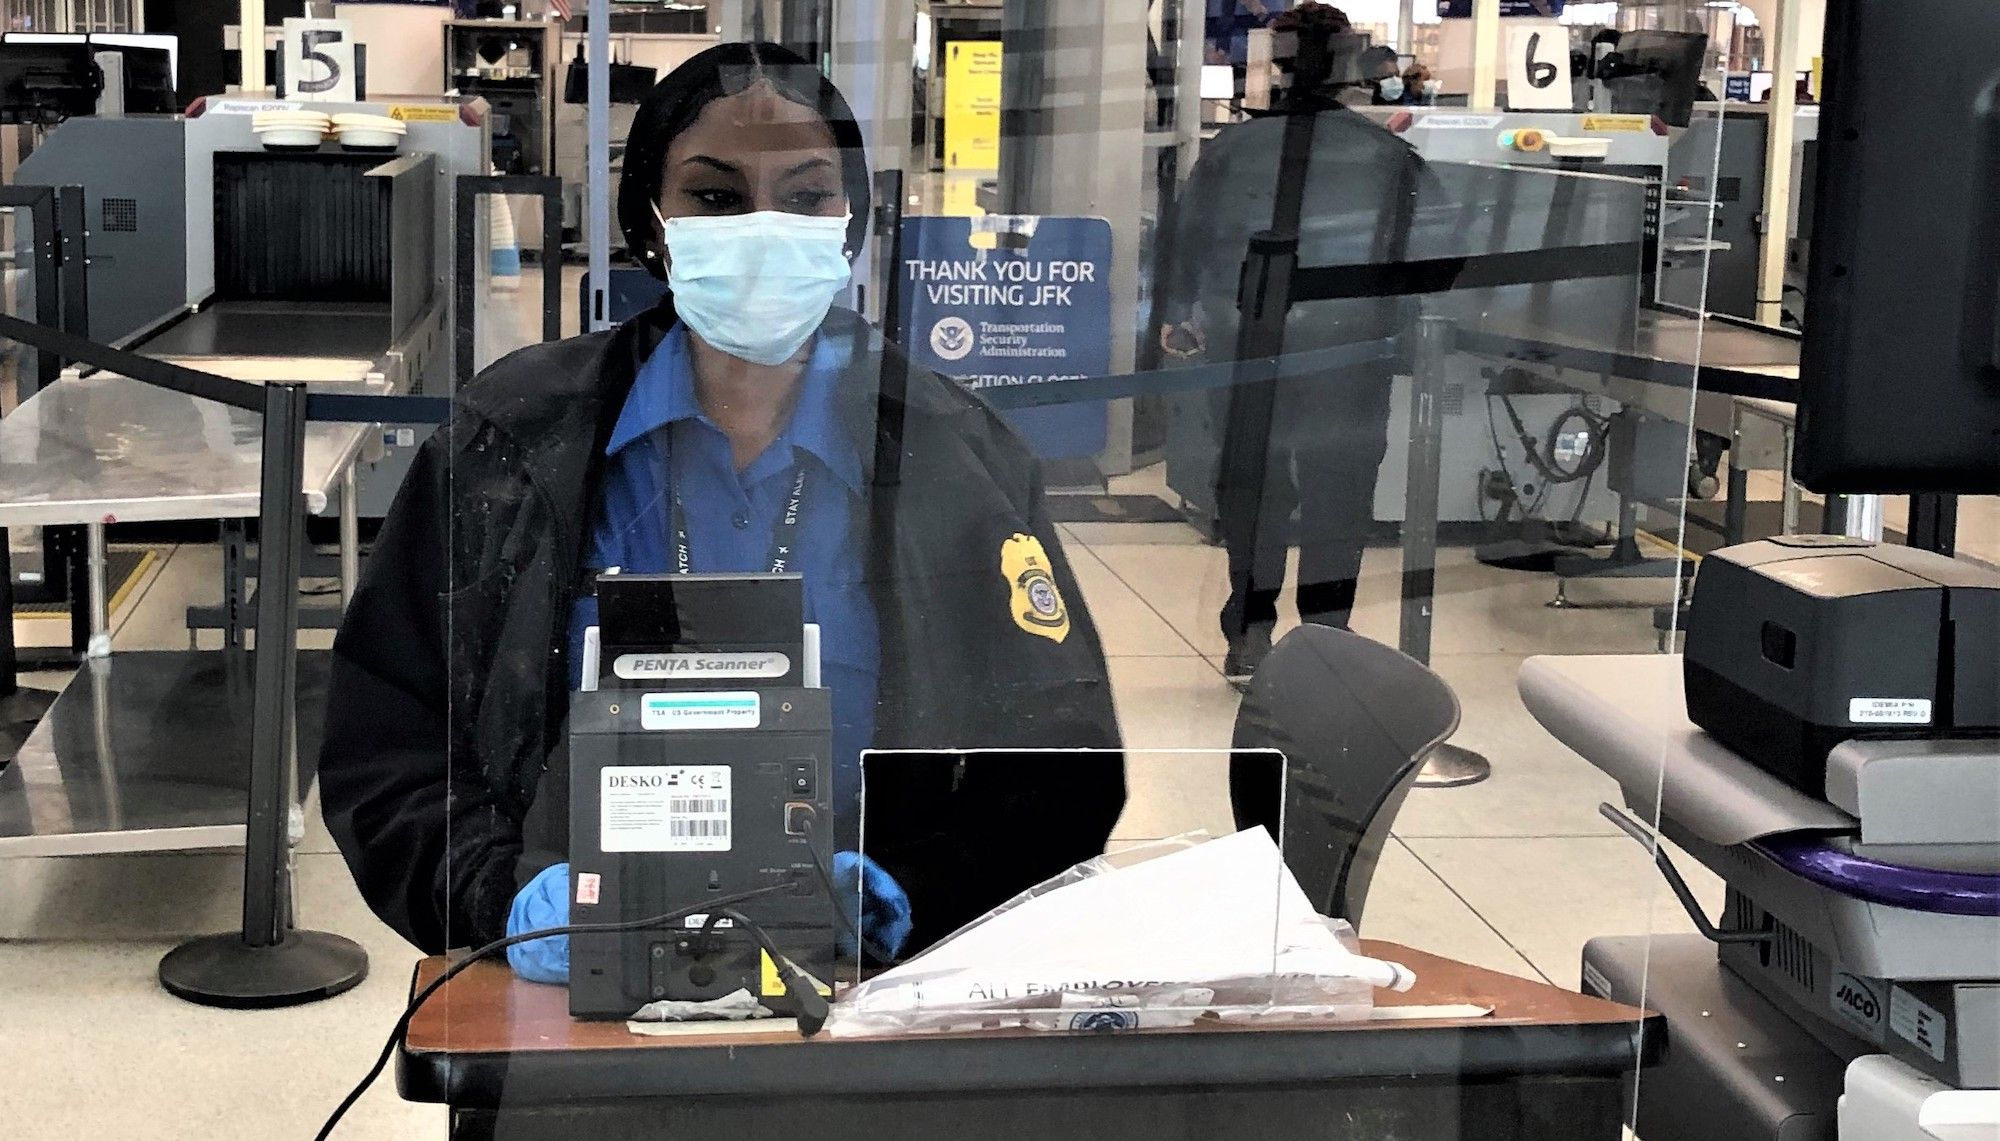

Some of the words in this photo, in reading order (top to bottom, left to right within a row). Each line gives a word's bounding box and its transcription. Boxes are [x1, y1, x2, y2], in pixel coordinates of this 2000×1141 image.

[298, 30, 343, 93] 5
[1525, 32, 1557, 88] 6
[905, 260, 987, 281] THANK
[993, 260, 1042, 282] YOU
[1049, 261, 1095, 283] FOR
[927, 284, 1024, 305] VISITING
[1029, 285, 1072, 306] JFK
[979, 322, 1065, 335] Transportation
[979, 336, 1028, 347] Security
[979, 346, 1067, 358] Administration
[784, 499, 799, 525] STAY
[678, 545, 689, 575] ATCH
[632, 659, 690, 672] PENTA
[726, 709, 755, 717] Property
[608, 775, 663, 788] DESKO
[1836, 985, 1875, 1018] JACO
